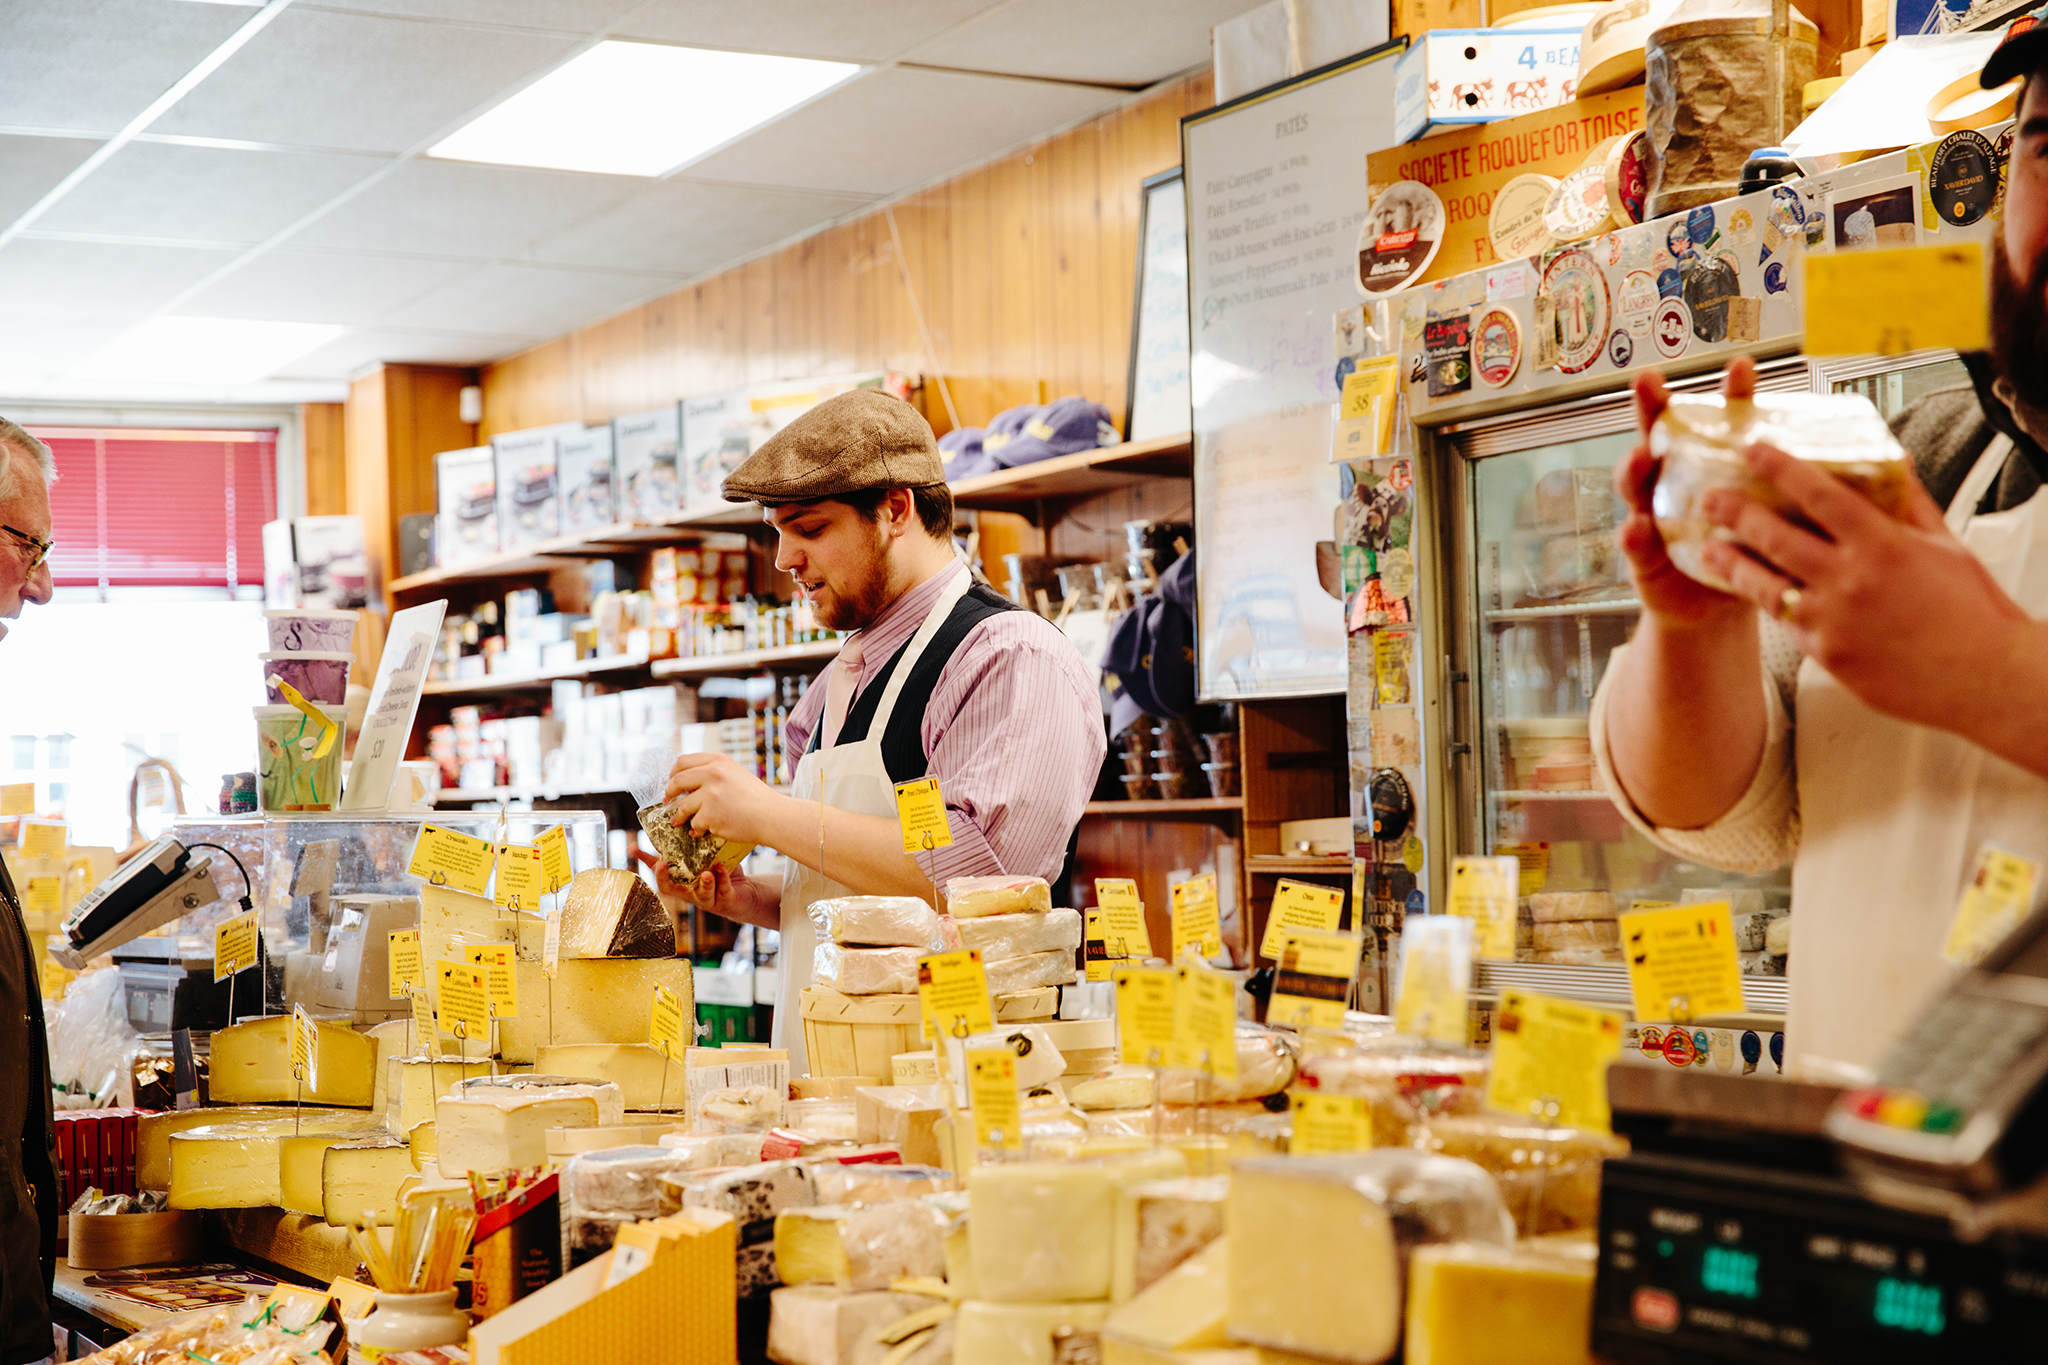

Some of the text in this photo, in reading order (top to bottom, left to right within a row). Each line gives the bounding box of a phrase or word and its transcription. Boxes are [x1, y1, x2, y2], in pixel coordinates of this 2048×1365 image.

[1518, 46, 1538, 70] 4
[1400, 106, 1640, 188] SOCIETE ROQUEFORTOISE
[1930, 132, 1997, 188] BEAUFORT CHALET D'ALPAGE
[446, 834, 468, 845] Crucolo
[1302, 893, 1314, 901] Oma
